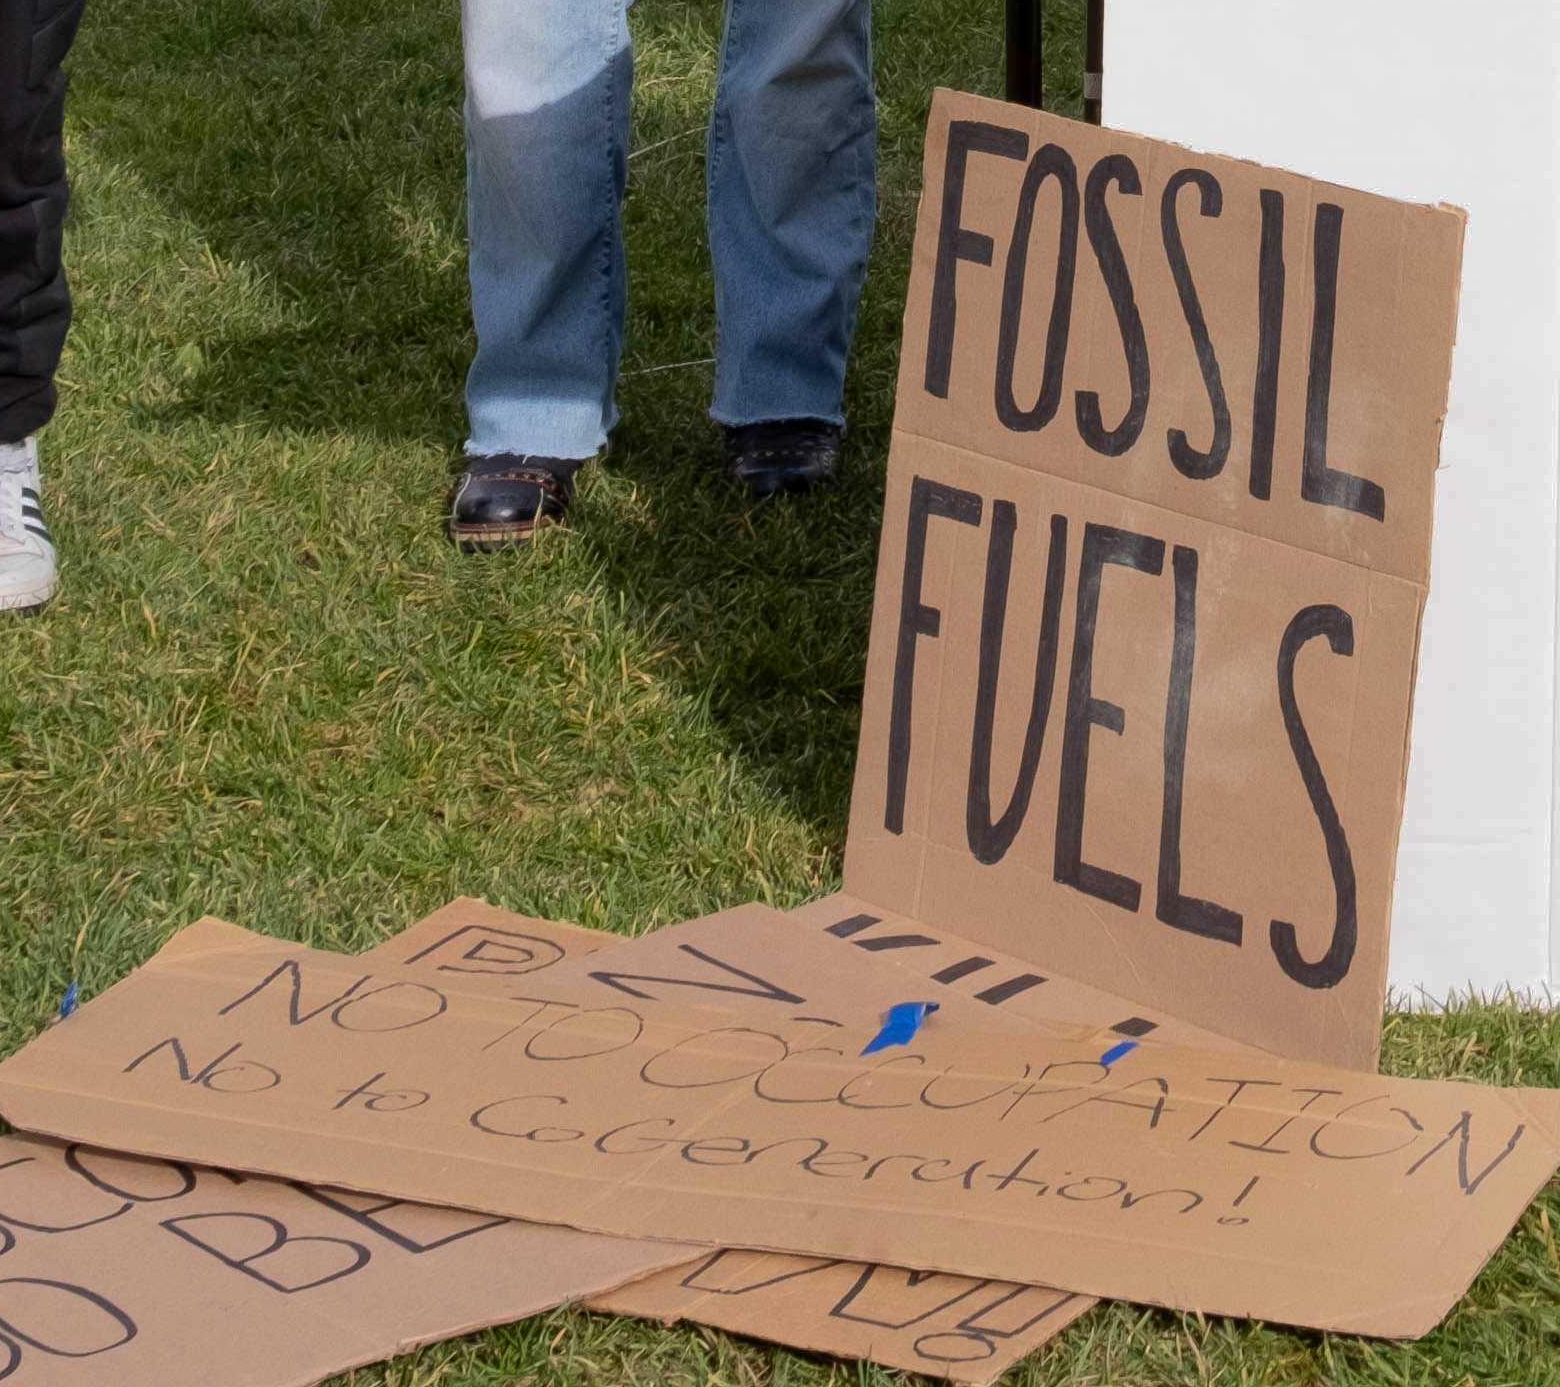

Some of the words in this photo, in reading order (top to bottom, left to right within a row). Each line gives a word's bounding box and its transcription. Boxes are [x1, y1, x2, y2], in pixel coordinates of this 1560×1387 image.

[920, 118, 1388, 525] FOSSIL
[884, 474, 1357, 991] FUELS
[218, 959, 448, 1033] NO
[482, 995, 644, 1061] TO
[640, 1025, 1526, 1197] OCCUPATION
[332, 1070, 432, 1112] to
